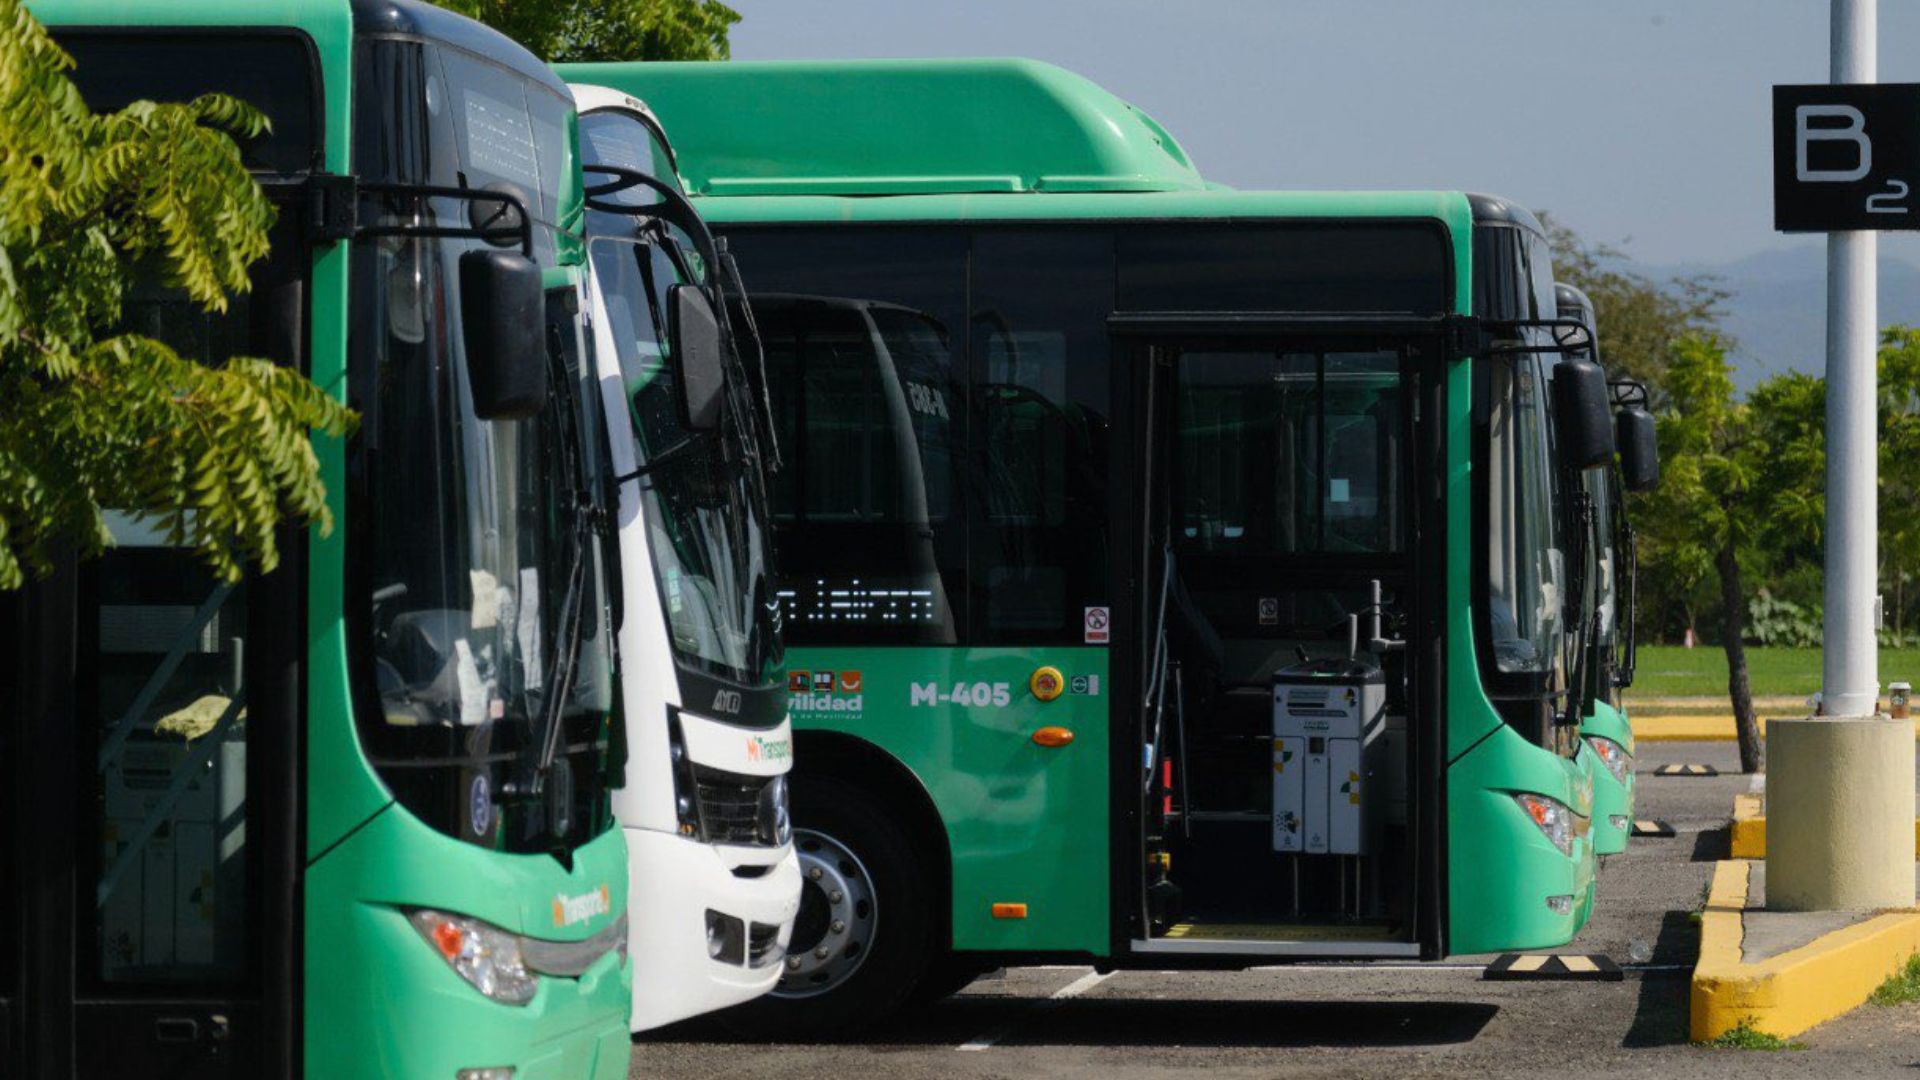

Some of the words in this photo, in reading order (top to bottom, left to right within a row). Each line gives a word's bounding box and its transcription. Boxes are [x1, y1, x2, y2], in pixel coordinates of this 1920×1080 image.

[1796, 104, 1872, 182] B
[1865, 179, 1909, 213] 2
[910, 681, 1011, 708] M-405
